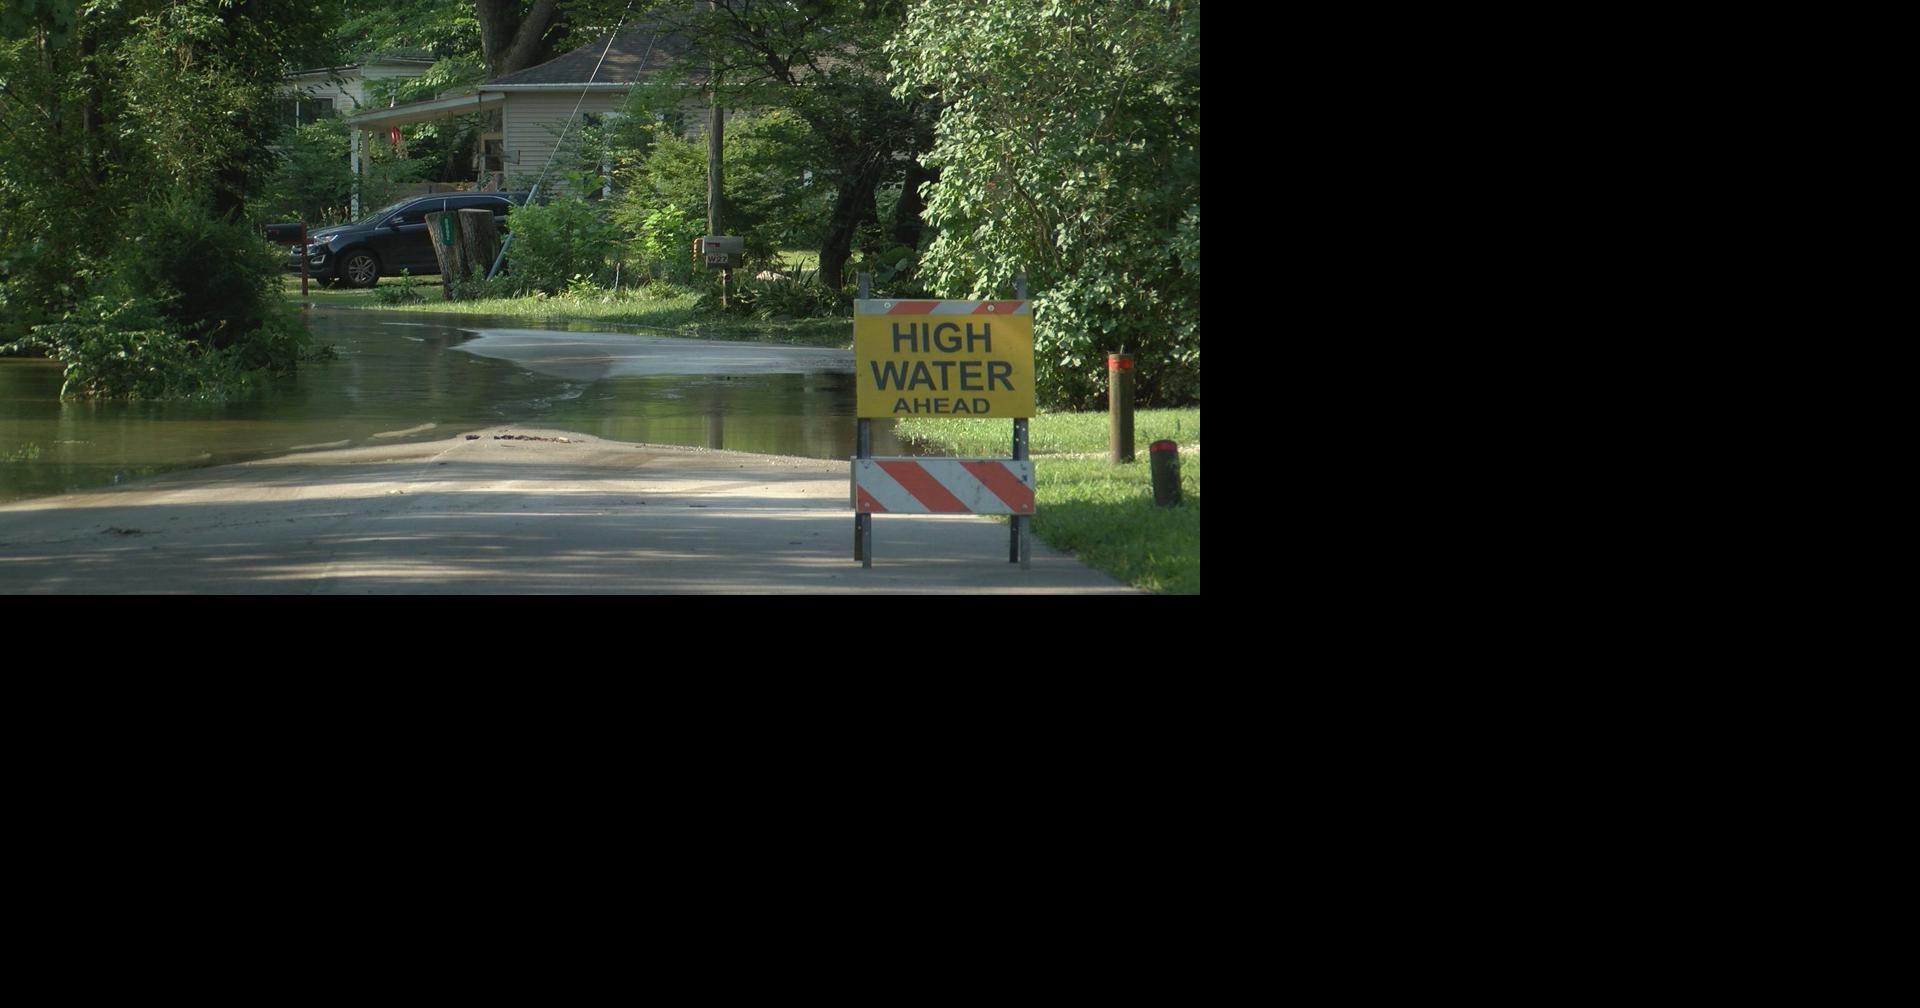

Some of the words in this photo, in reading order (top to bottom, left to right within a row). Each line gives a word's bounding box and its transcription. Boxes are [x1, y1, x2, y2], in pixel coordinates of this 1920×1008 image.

[892, 322, 992, 353] HIGH
[870, 360, 1015, 391] WATER
[892, 397, 991, 414] AHEAD
